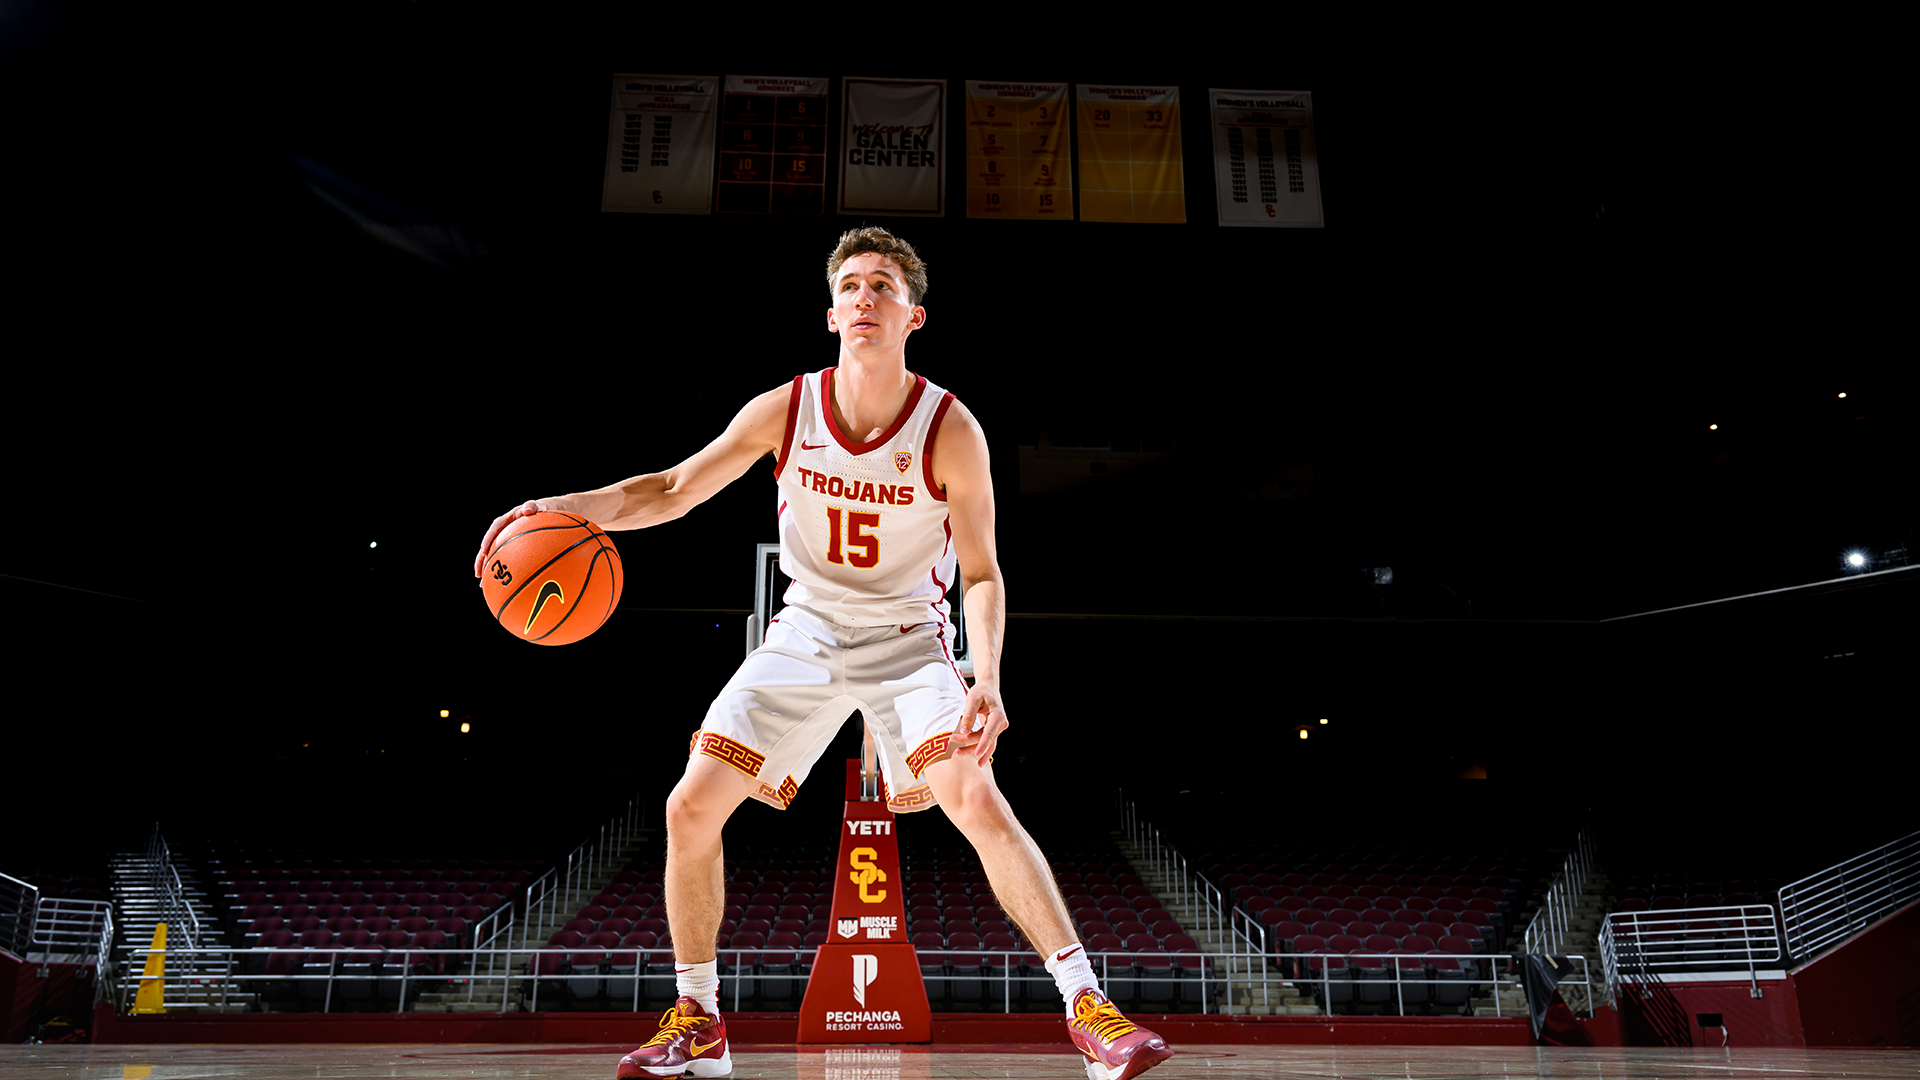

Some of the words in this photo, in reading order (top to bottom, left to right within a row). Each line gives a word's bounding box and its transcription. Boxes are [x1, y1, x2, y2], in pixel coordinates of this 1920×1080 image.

[767, 79, 810, 87] VOLLEYBALL
[746, 100, 751, 111] 1
[798, 101, 806, 114] 6
[1217, 99, 1254, 107] WOMEN'S
[988, 106, 995, 117] 2
[1040, 107, 1047, 119] 3
[1095, 110, 1110, 120] 20
[1147, 111, 1162, 122] 33
[743, 129, 751, 140] 8
[796, 131, 804, 142] 9
[988, 134, 995, 145] 5
[857, 132, 927, 149] GALEN
[1040, 136, 1048, 146] 7
[850, 149, 934, 167] CENTER
[739, 159, 752, 170] 10
[792, 160, 806, 172] 15
[989, 161, 996, 172] 8
[1042, 165, 1049, 176] 9
[986, 193, 999, 205] 10
[1040, 194, 1053, 206] 15
[797, 466, 915, 505] TROJANS
[826, 506, 881, 569] 15
[846, 820, 892, 835] YETI
[850, 847, 887, 903] SC
[860, 916, 897, 928] MUSCLE
[867, 928, 891, 939] MILK
[826, 1011, 901, 1022] PECHANGA
[826, 1023, 862, 1031] RESORT
